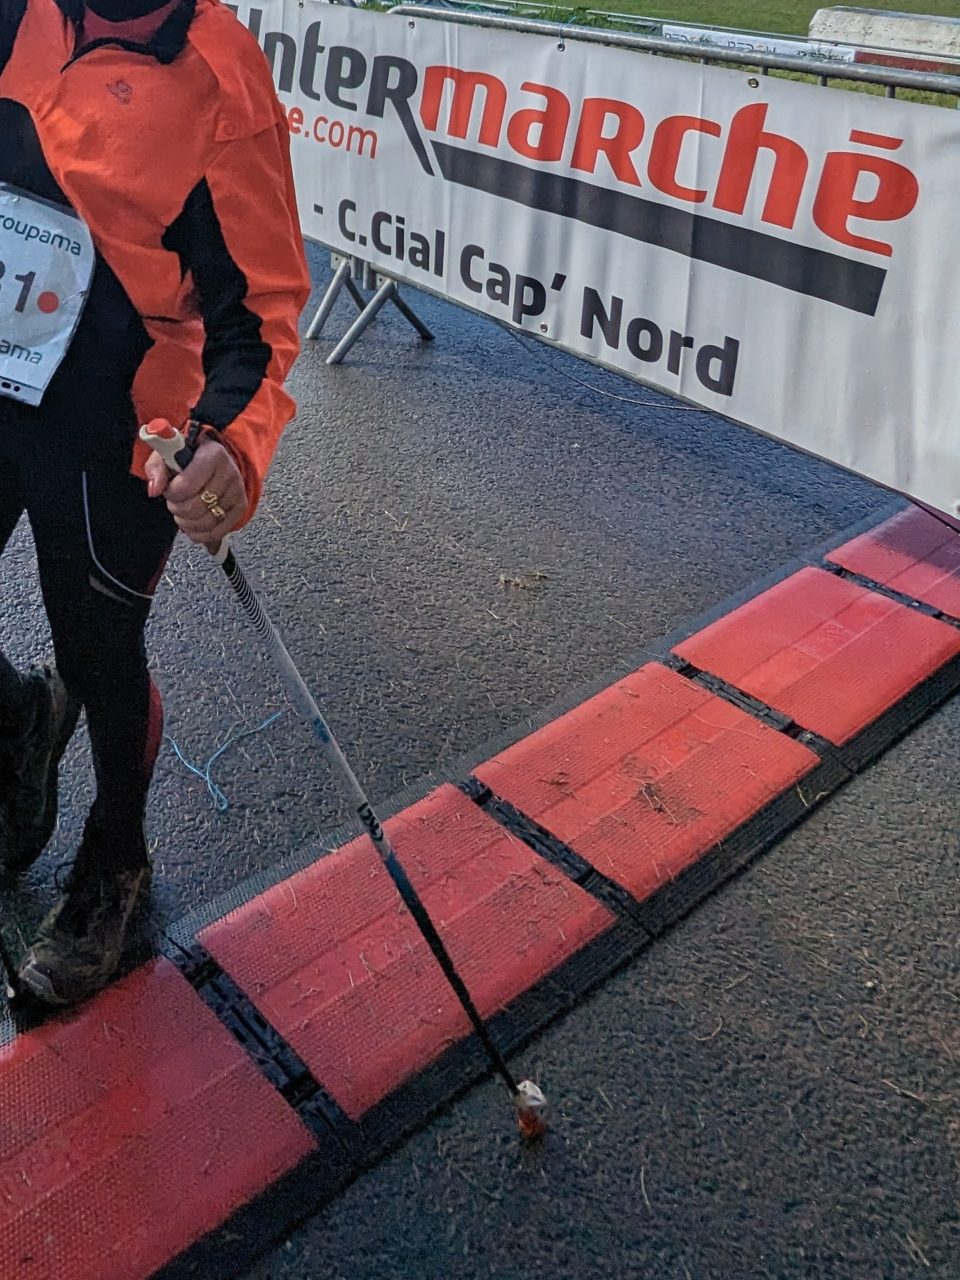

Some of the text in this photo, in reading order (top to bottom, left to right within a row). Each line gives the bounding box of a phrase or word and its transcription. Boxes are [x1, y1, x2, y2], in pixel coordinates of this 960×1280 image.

[280, 102, 378, 160] e.com
[338, 198, 445, 278] C.Cial
[580, 286, 740, 397] Nord
